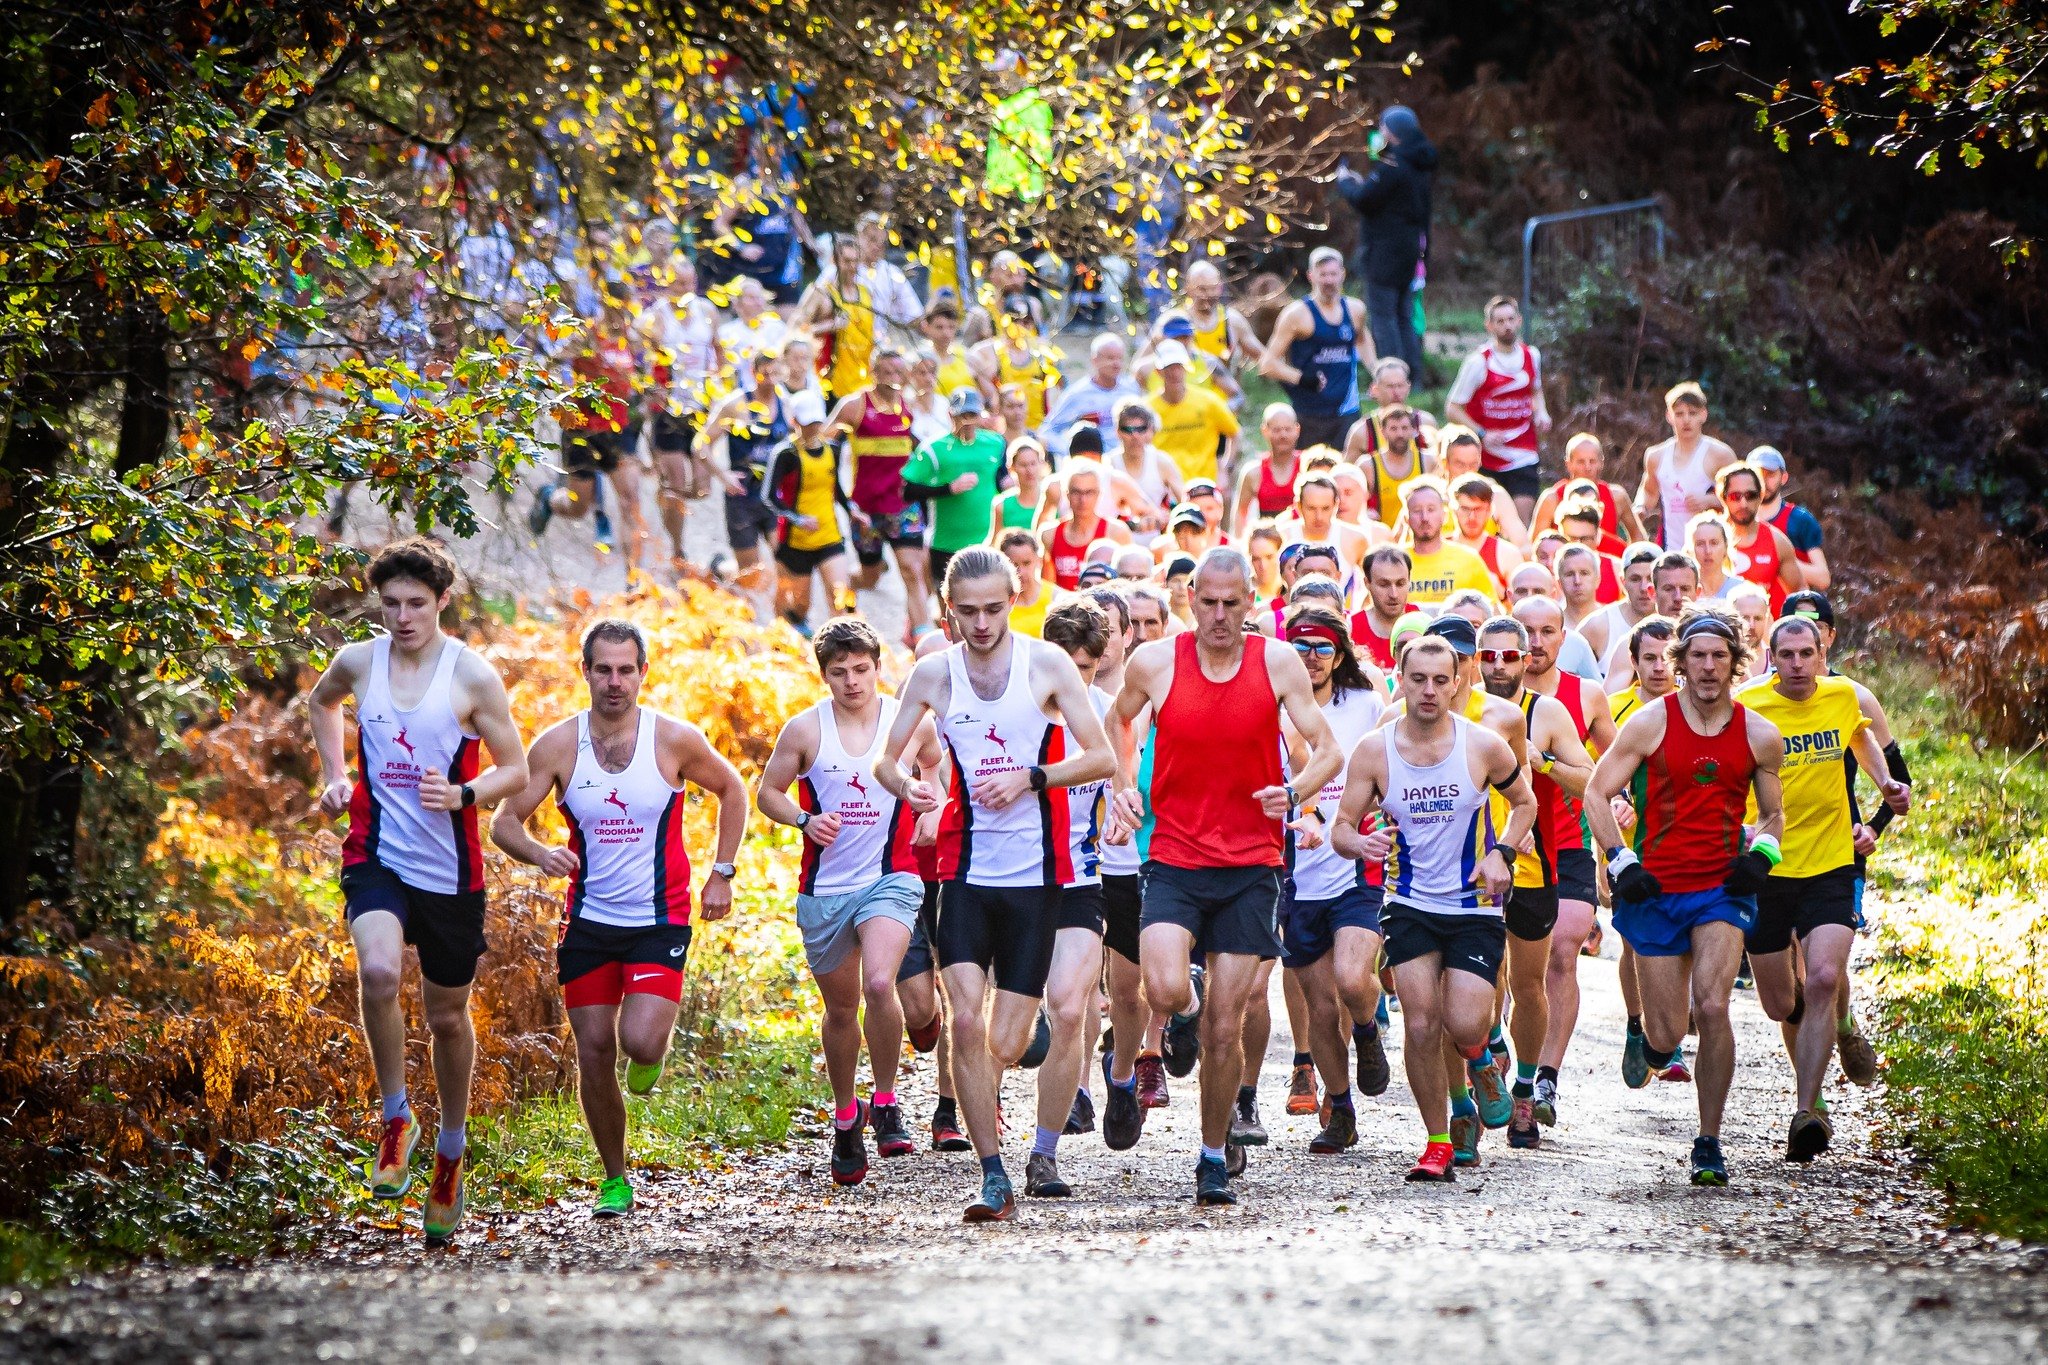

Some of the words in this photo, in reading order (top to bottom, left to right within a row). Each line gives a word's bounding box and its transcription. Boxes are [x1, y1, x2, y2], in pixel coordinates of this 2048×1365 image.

[1783, 729, 1840, 755] DSPORT
[980, 756, 1005, 766] FLEET
[1006, 755, 1014, 764] &
[386, 762, 412, 771] FLEET
[413, 764, 421, 773] &
[379, 772, 422, 782] CROOKHA
[1402, 784, 1460, 801] JAMES
[841, 801, 864, 809] FLEET
[865, 801, 872, 809] &
[835, 810, 880, 818] ROOKHAM
[600, 818, 626, 826] FLEET
[1411, 815, 1441, 825] BORDER
[1441, 814, 1455, 823] A.C.
[594, 827, 644, 836] CROOKHAM
